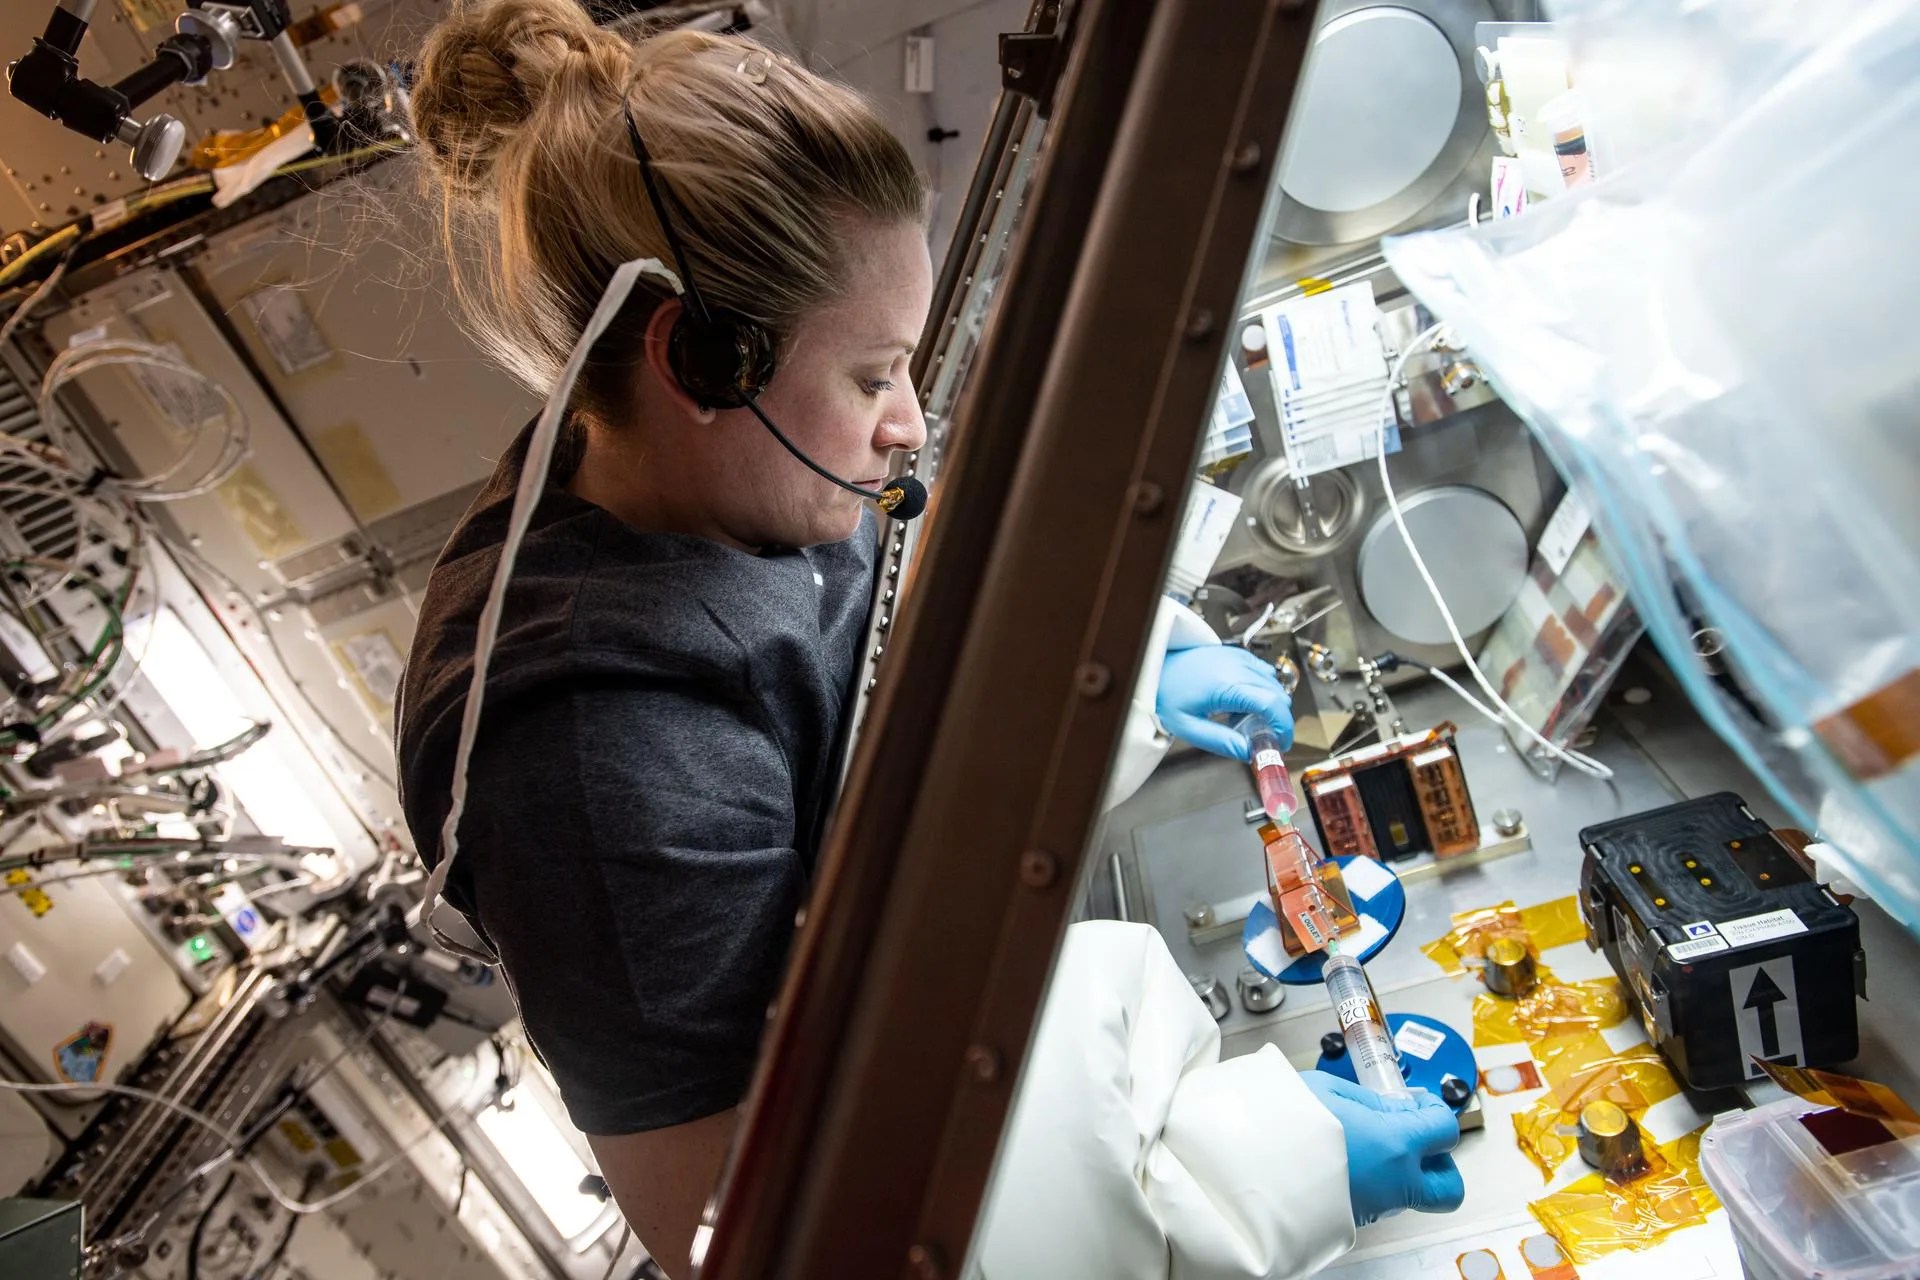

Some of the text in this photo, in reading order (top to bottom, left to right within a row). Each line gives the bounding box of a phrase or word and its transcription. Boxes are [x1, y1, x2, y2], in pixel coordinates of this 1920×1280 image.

[1304, 918, 1320, 937] OUTLET
[1756, 915, 1785, 925] Habitat
[1342, 1006, 1367, 1024] D2
